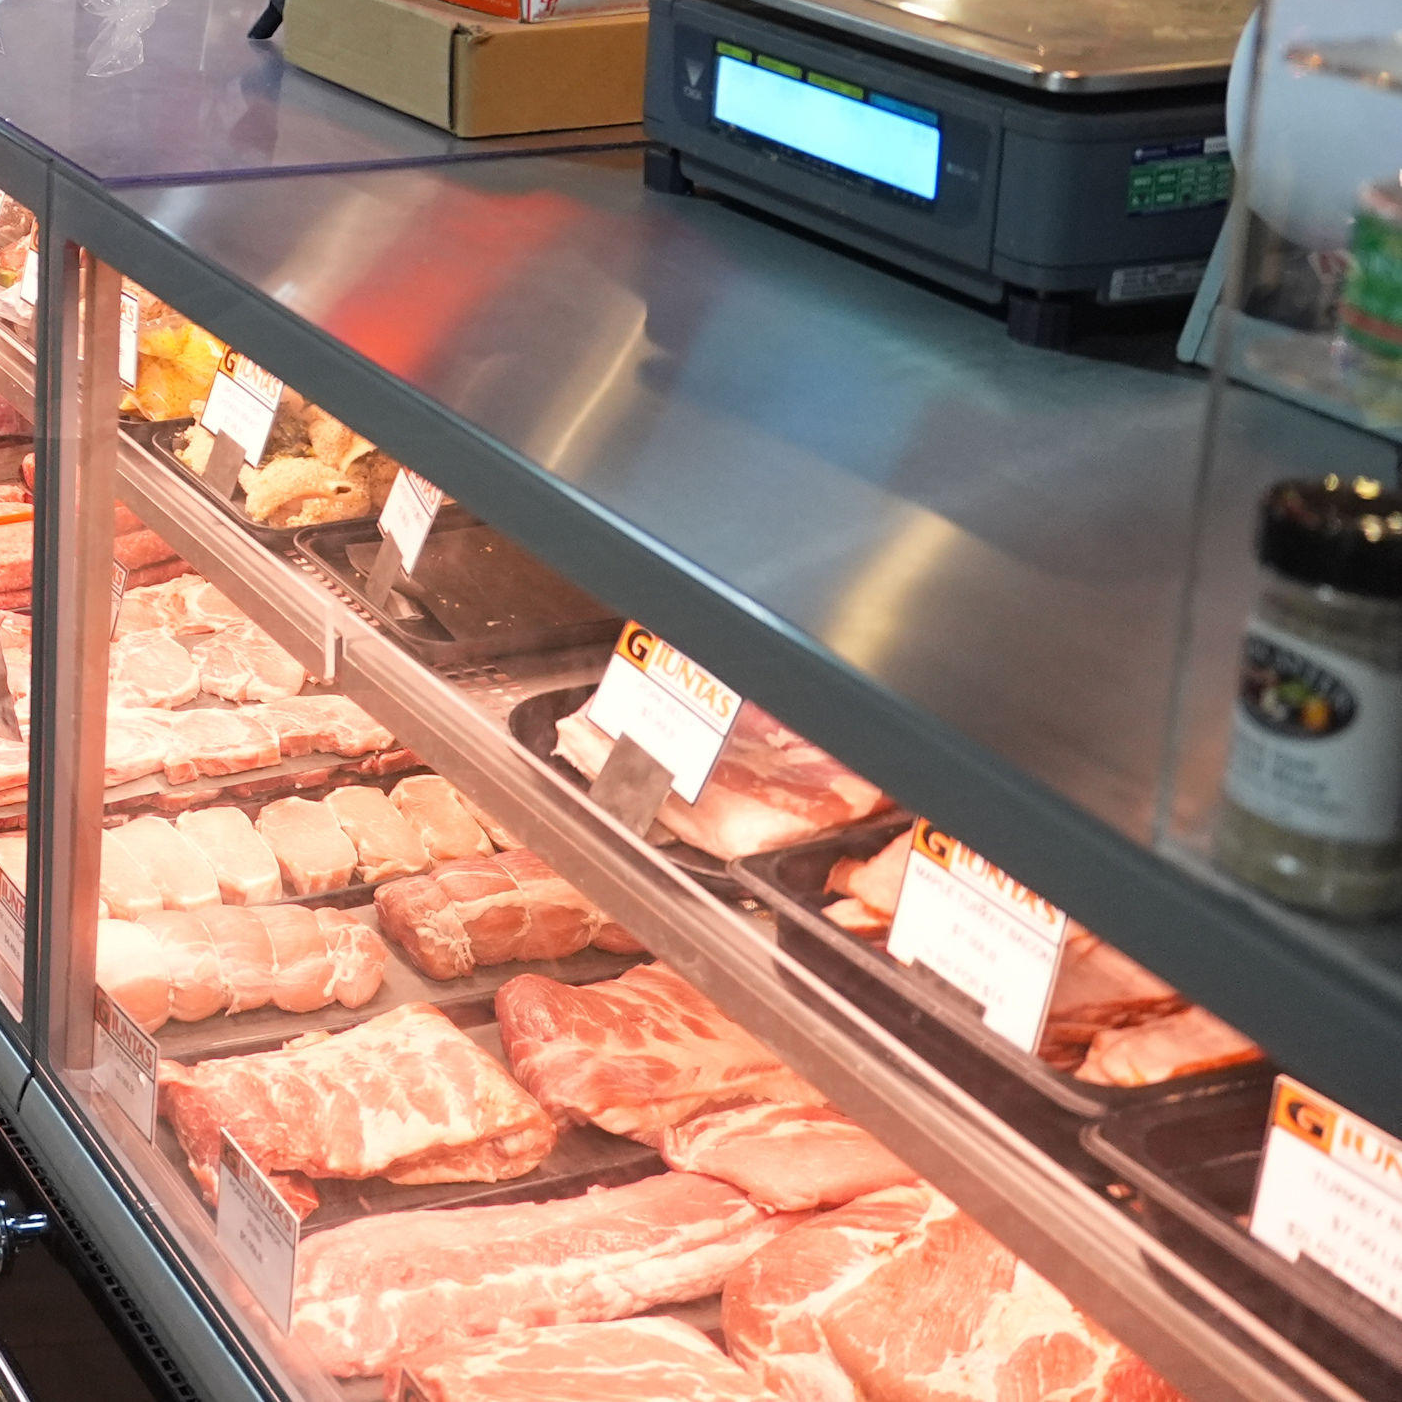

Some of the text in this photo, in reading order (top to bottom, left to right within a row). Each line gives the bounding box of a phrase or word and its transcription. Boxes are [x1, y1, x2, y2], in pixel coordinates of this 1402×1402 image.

[625, 628, 733, 720] GIUNTA'S
[920, 824, 1059, 927] GIUNTA'S
[97, 998, 154, 1070] GIUNTA'S
[1288, 1101, 1402, 1170] GIUN
[222, 1139, 293, 1232] GIUNTA'S
